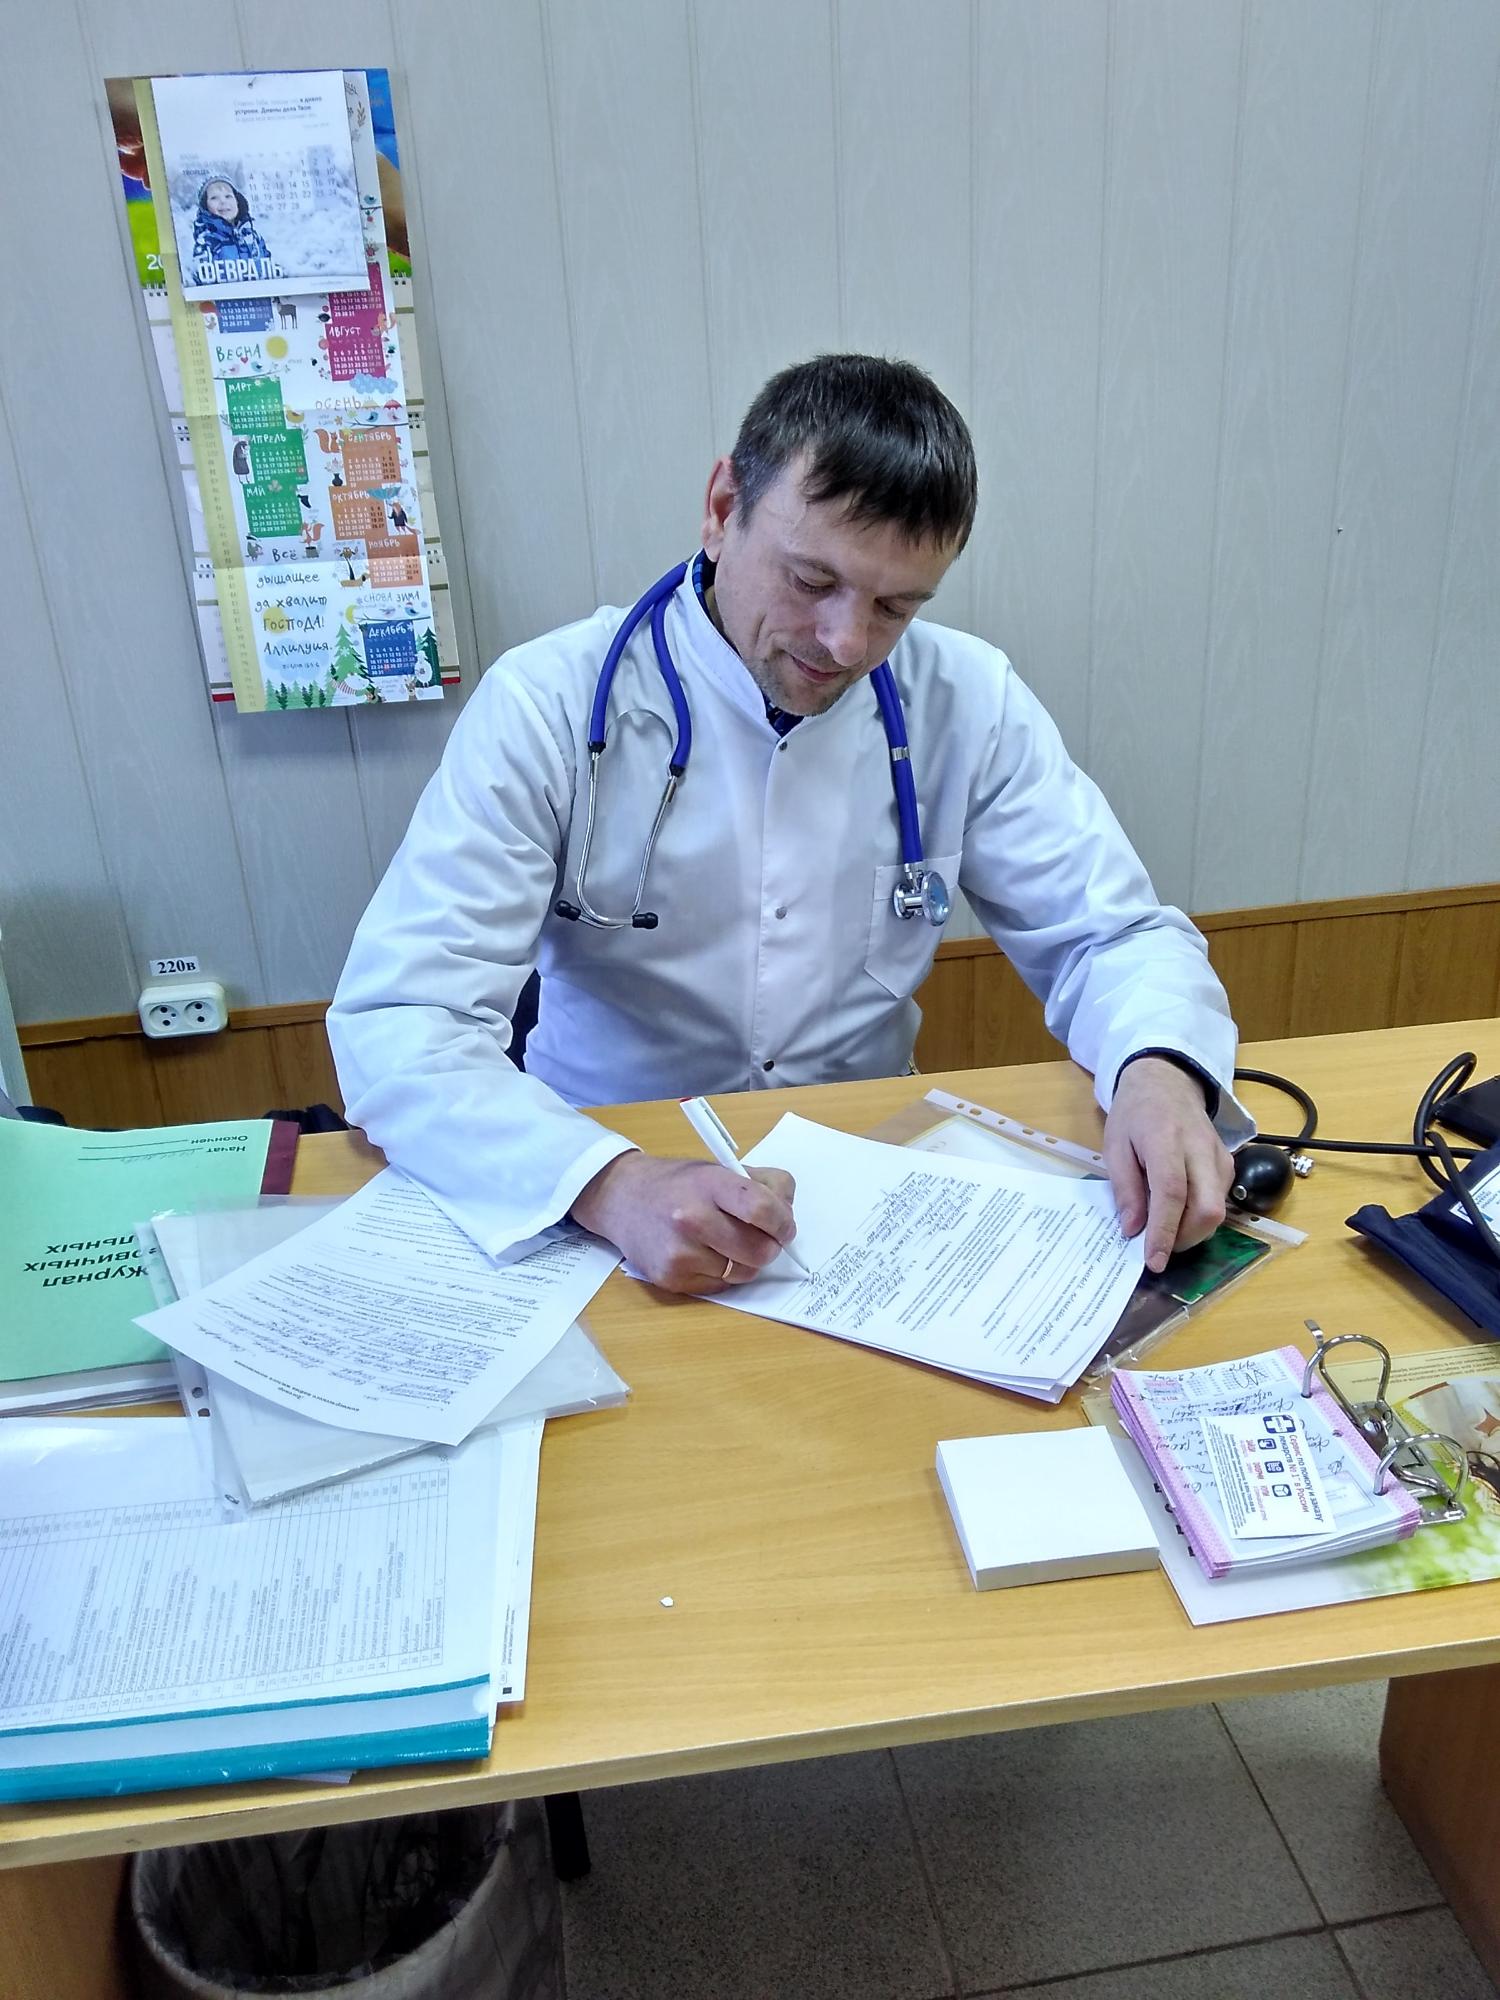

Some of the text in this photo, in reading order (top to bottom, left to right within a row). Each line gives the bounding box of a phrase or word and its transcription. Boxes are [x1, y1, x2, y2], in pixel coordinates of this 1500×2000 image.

[199, 257, 283, 282] ФЕВРАЛЬ
[329, 326, 360, 337] АВГУСТ
[216, 343, 262, 362] ВЕСНА
[228, 382, 251, 394] МАРТ
[315, 395, 362, 410] ОСЕНЬ
[251, 434, 286, 444] АПРЕЛЬ
[348, 432, 392, 442] СЕНТЯБРЬ
[246, 486, 266, 498] МАЙ
[332, 490, 370, 503] ОКТЯБРЬ
[368, 539, 400, 549] НОЯБРЬ
[272, 548, 298, 562] Всё
[256, 572, 320, 588] дышащее
[364, 590, 420, 602] СНОВА ЗИМА
[254, 595, 328, 613] да хвалит
[368, 624, 408, 638] ДЕКАБРЬ
[157, 960, 196, 974] 220в
[190, 1135, 248, 1145] Окончен
[206, 1145, 246, 1153] Начат
[46, 1234, 136, 1254] льных
[42, 1266, 149, 1288] Журнал
